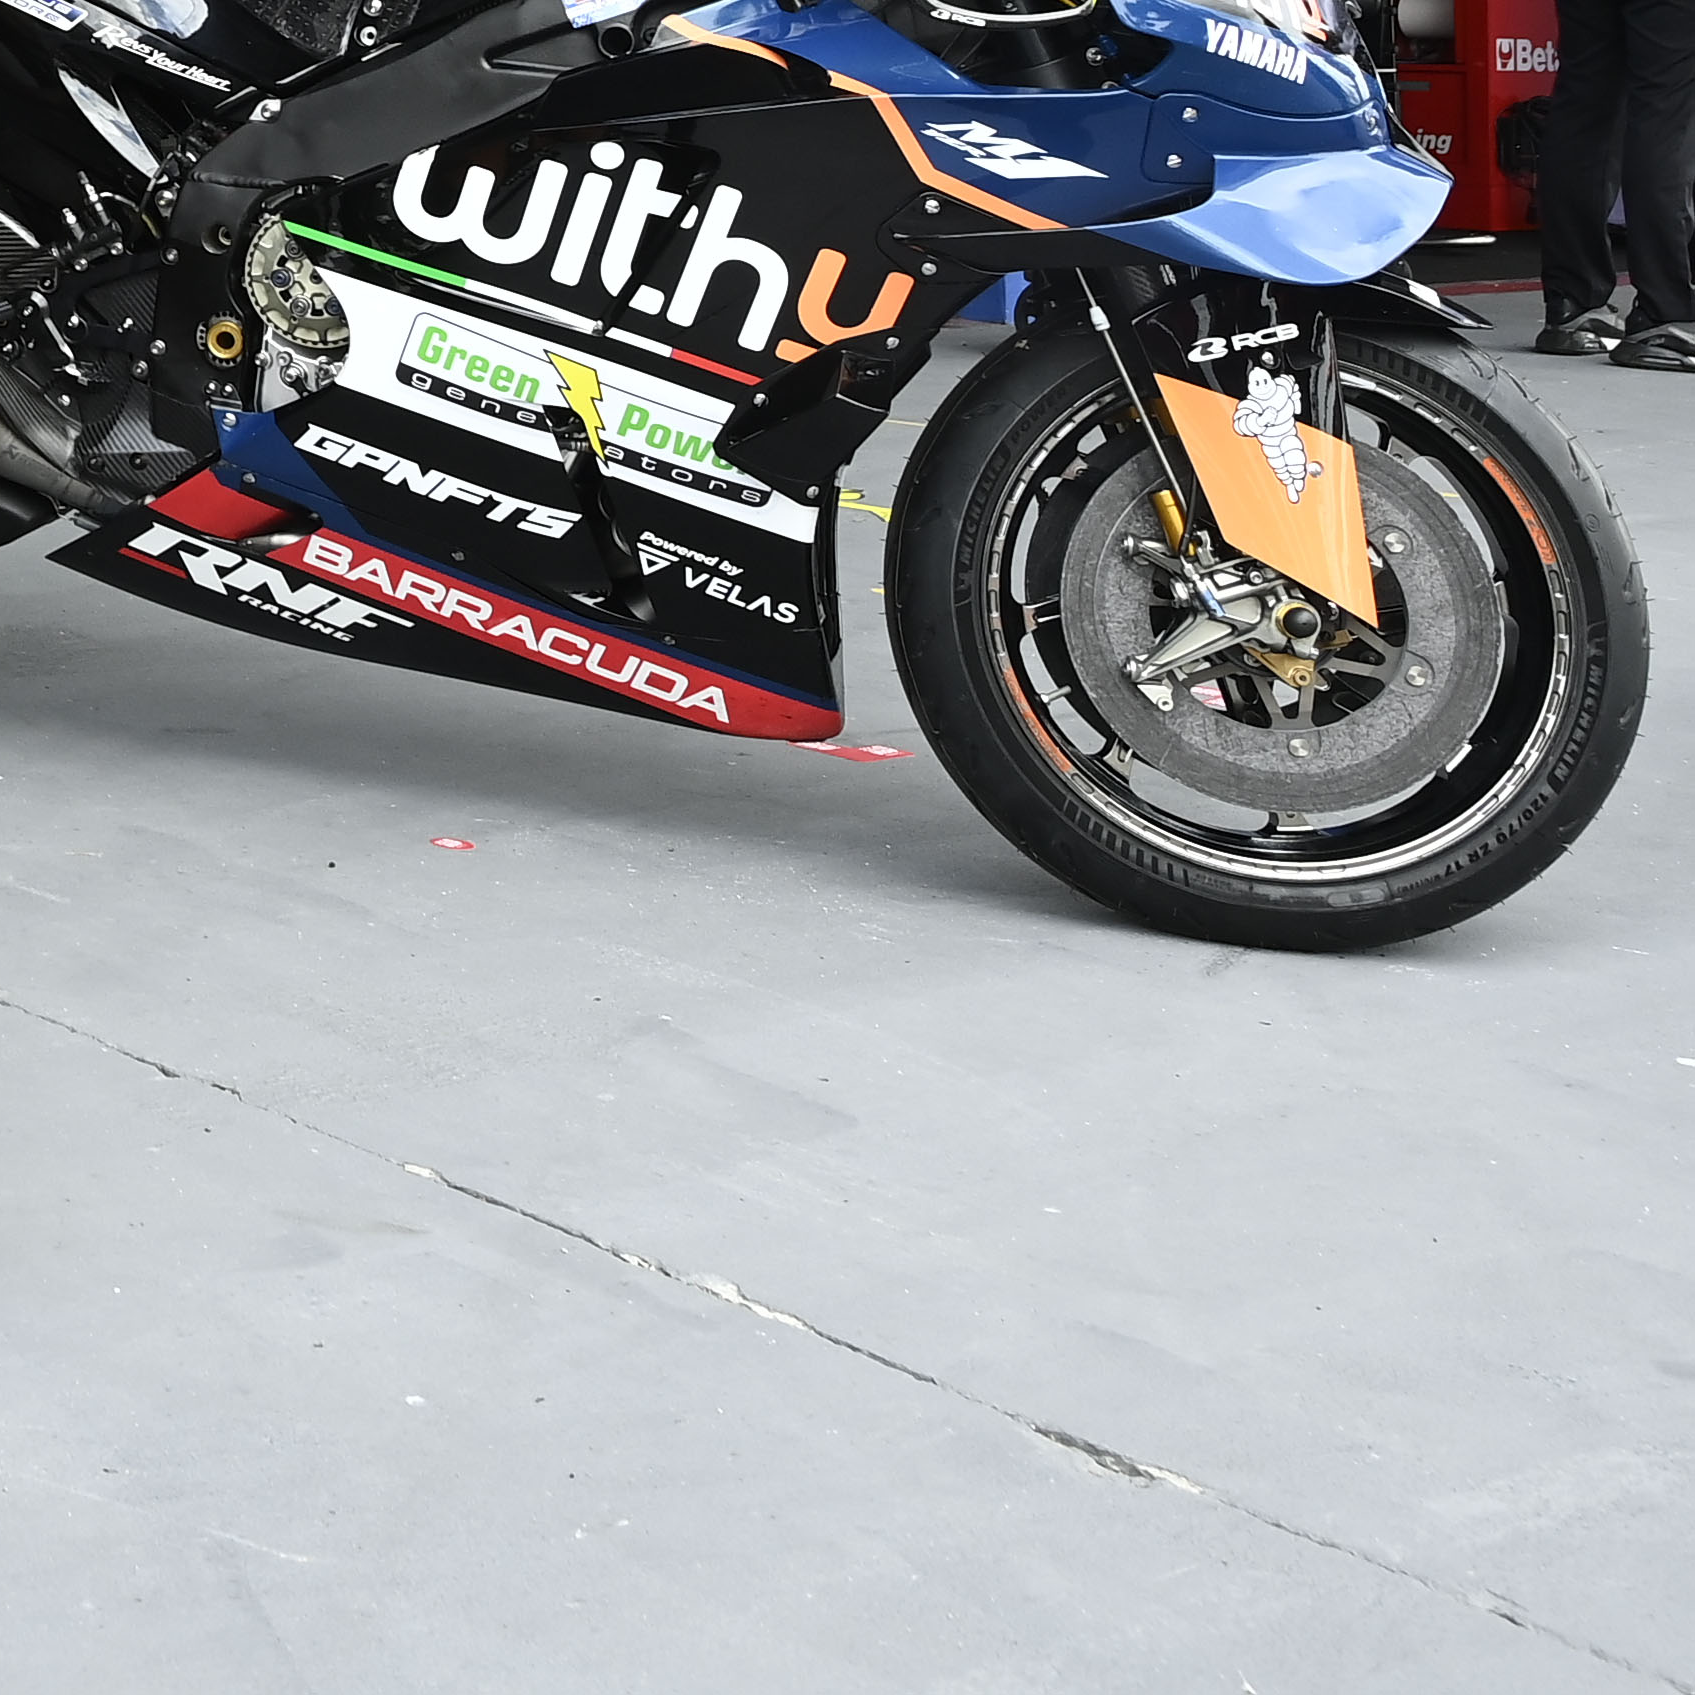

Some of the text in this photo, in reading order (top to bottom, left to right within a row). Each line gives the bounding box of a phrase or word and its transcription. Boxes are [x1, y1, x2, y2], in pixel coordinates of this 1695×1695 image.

[1205, 17, 1307, 85] YAMAHA
[1516, 38, 1560, 72] Bet
[417, 326, 540, 404] Green
[1232, 321, 1299, 351] RCB
[616, 404, 755, 479] Pow
[293, 423, 584, 539] GPNFTS
[123, 521, 415, 632] RNF
[639, 530, 744, 577] powered by
[237, 593, 356, 643] RACING
[300, 535, 732, 725] BARRACUDA
[1496, 792, 1549, 847] 120/70
